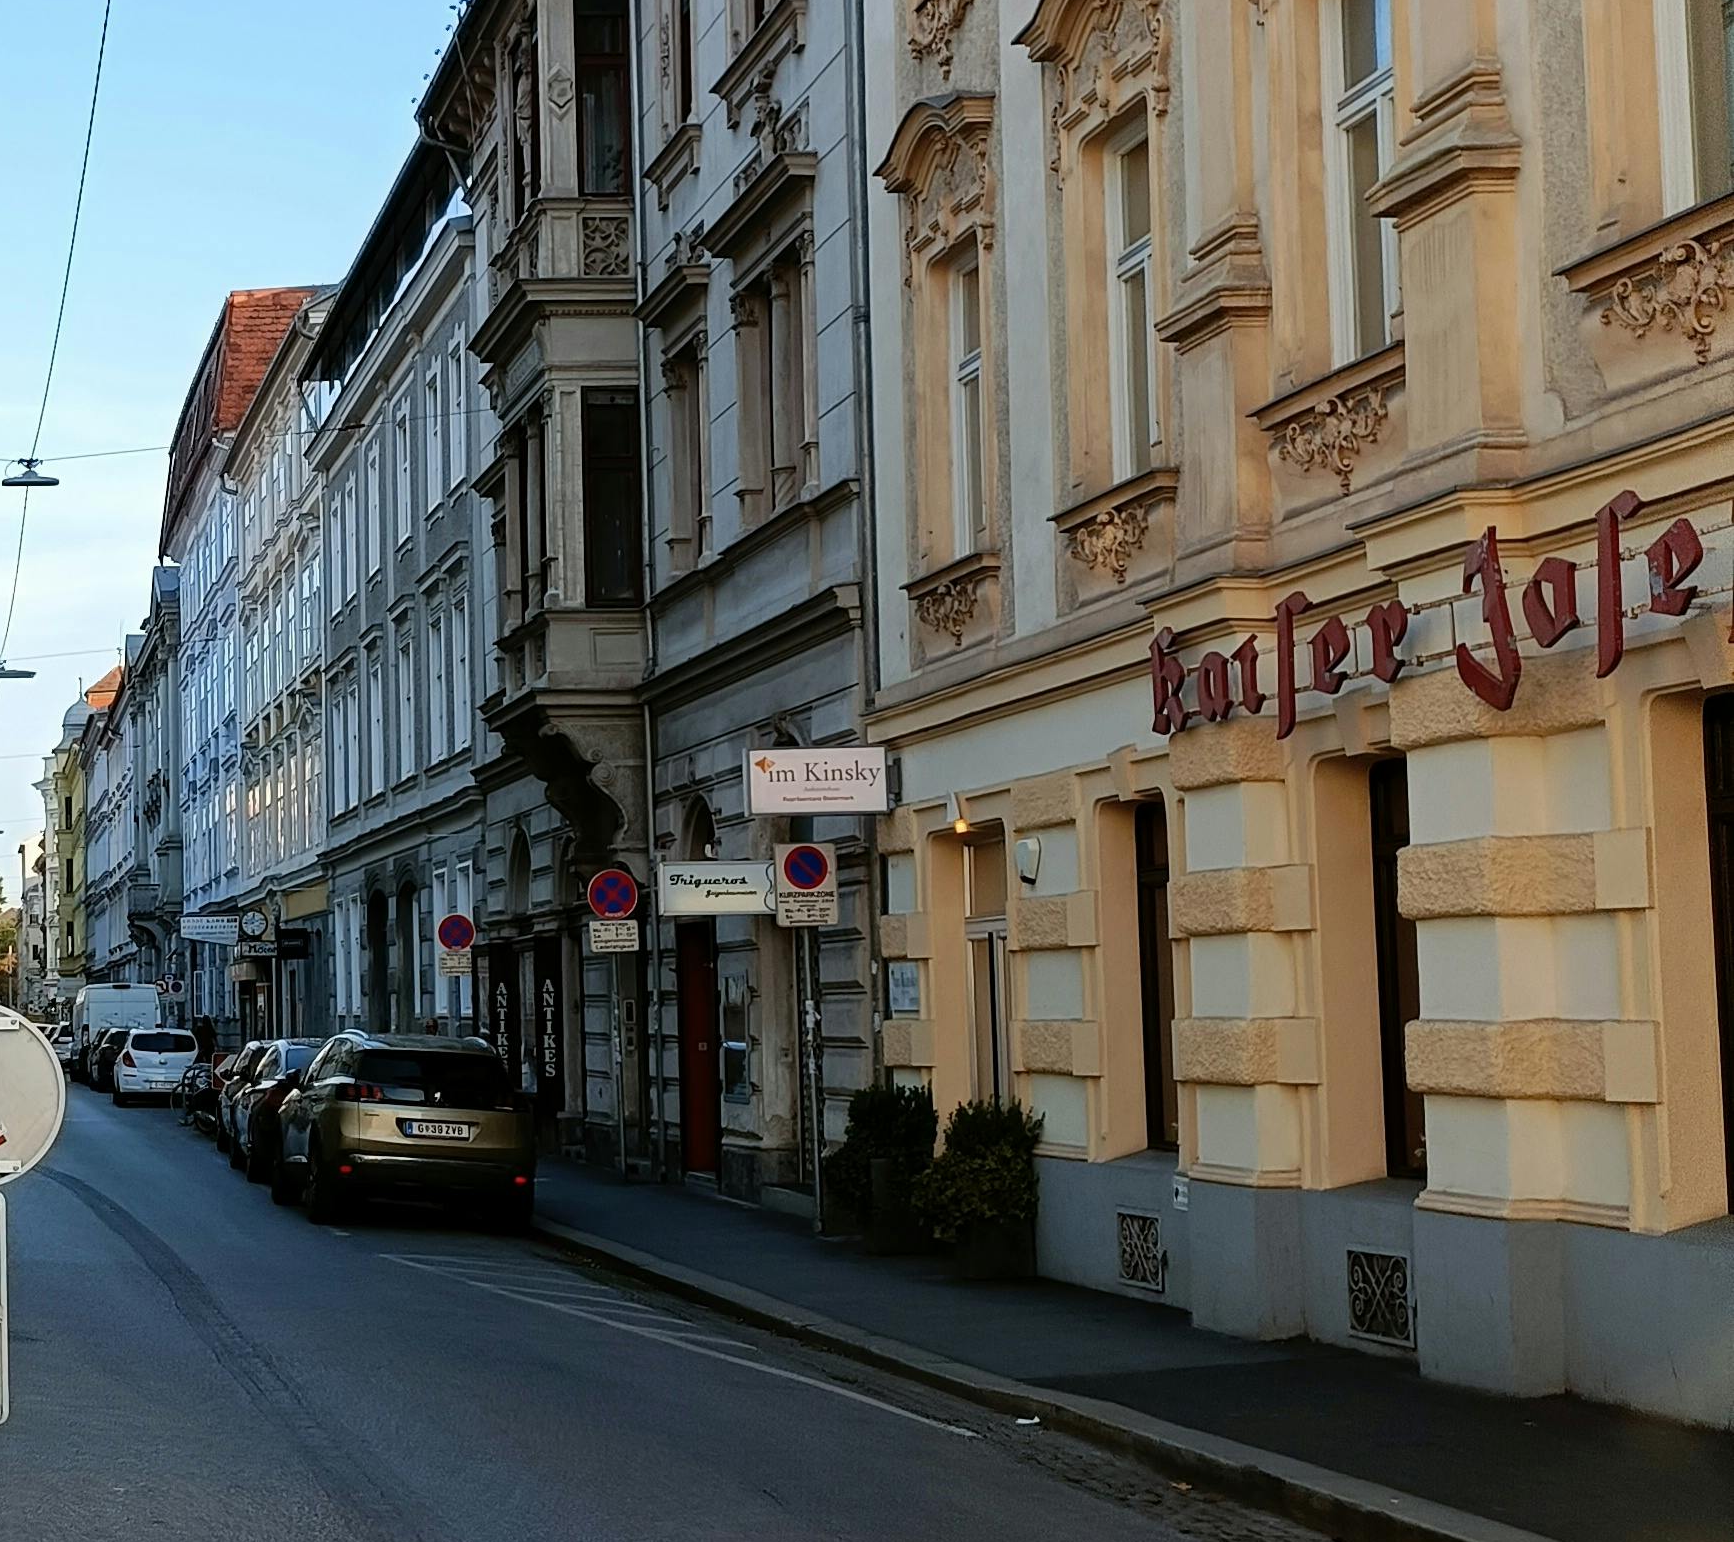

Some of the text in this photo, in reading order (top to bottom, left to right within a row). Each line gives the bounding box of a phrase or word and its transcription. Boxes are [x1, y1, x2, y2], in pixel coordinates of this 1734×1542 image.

[768, 759, 882, 787] im Kinsky
[669, 874, 749, 888] Trigueros
[542, 978, 556, 1077] ANTIKES
